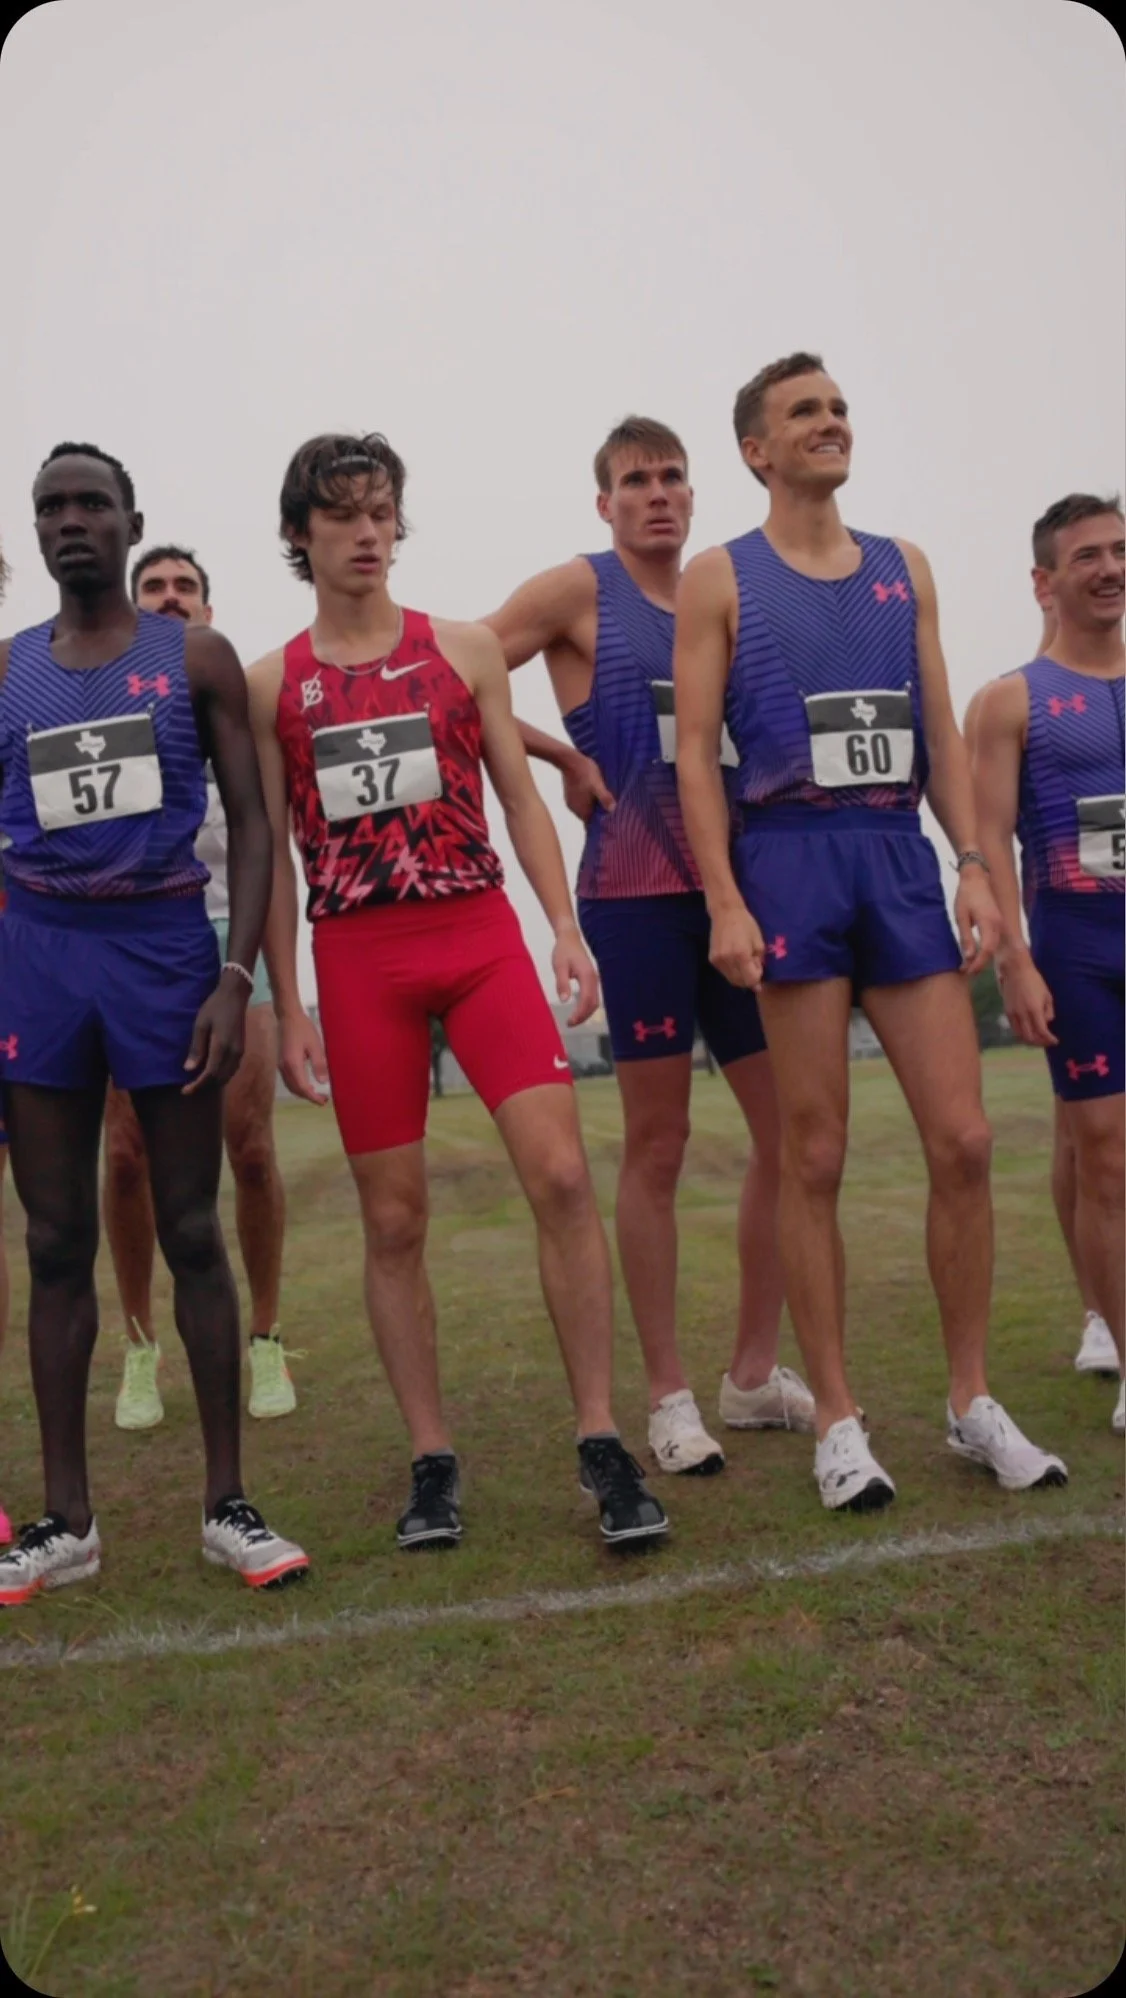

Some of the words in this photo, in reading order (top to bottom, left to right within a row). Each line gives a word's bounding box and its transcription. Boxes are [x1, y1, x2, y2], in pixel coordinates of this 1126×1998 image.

[846, 732, 892, 776] 60
[69, 763, 121, 815] 57
[352, 758, 400, 806] 37
